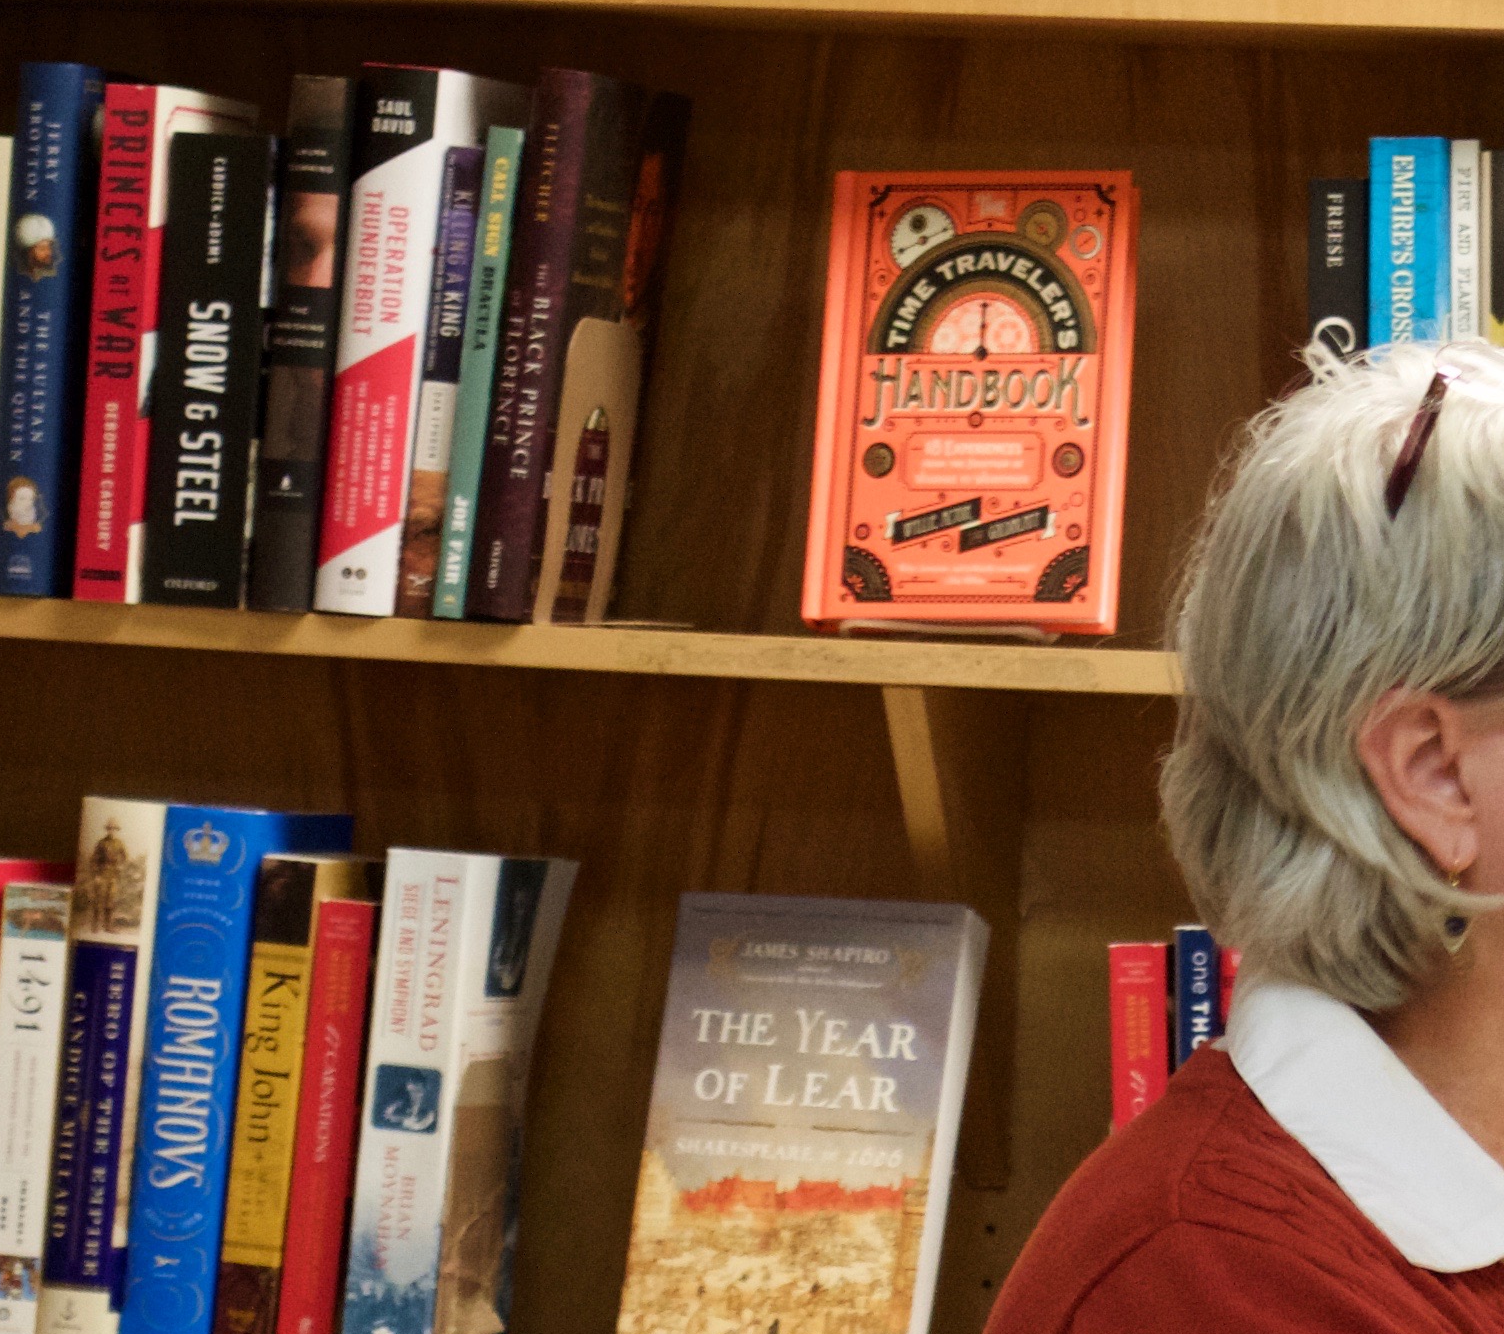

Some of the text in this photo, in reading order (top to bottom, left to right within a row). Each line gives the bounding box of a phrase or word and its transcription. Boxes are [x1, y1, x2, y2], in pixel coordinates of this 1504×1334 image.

[887, 252, 1079, 349] TIME TRAVELER'S
[174, 301, 231, 528] SNOW & STEEL
[862, 357, 1090, 428] HANDBOOK
[692, 1008, 918, 1062] THE YEAR
[148, 974, 222, 1190] ROMANOVS
[694, 1065, 899, 1112] OF LEAR
